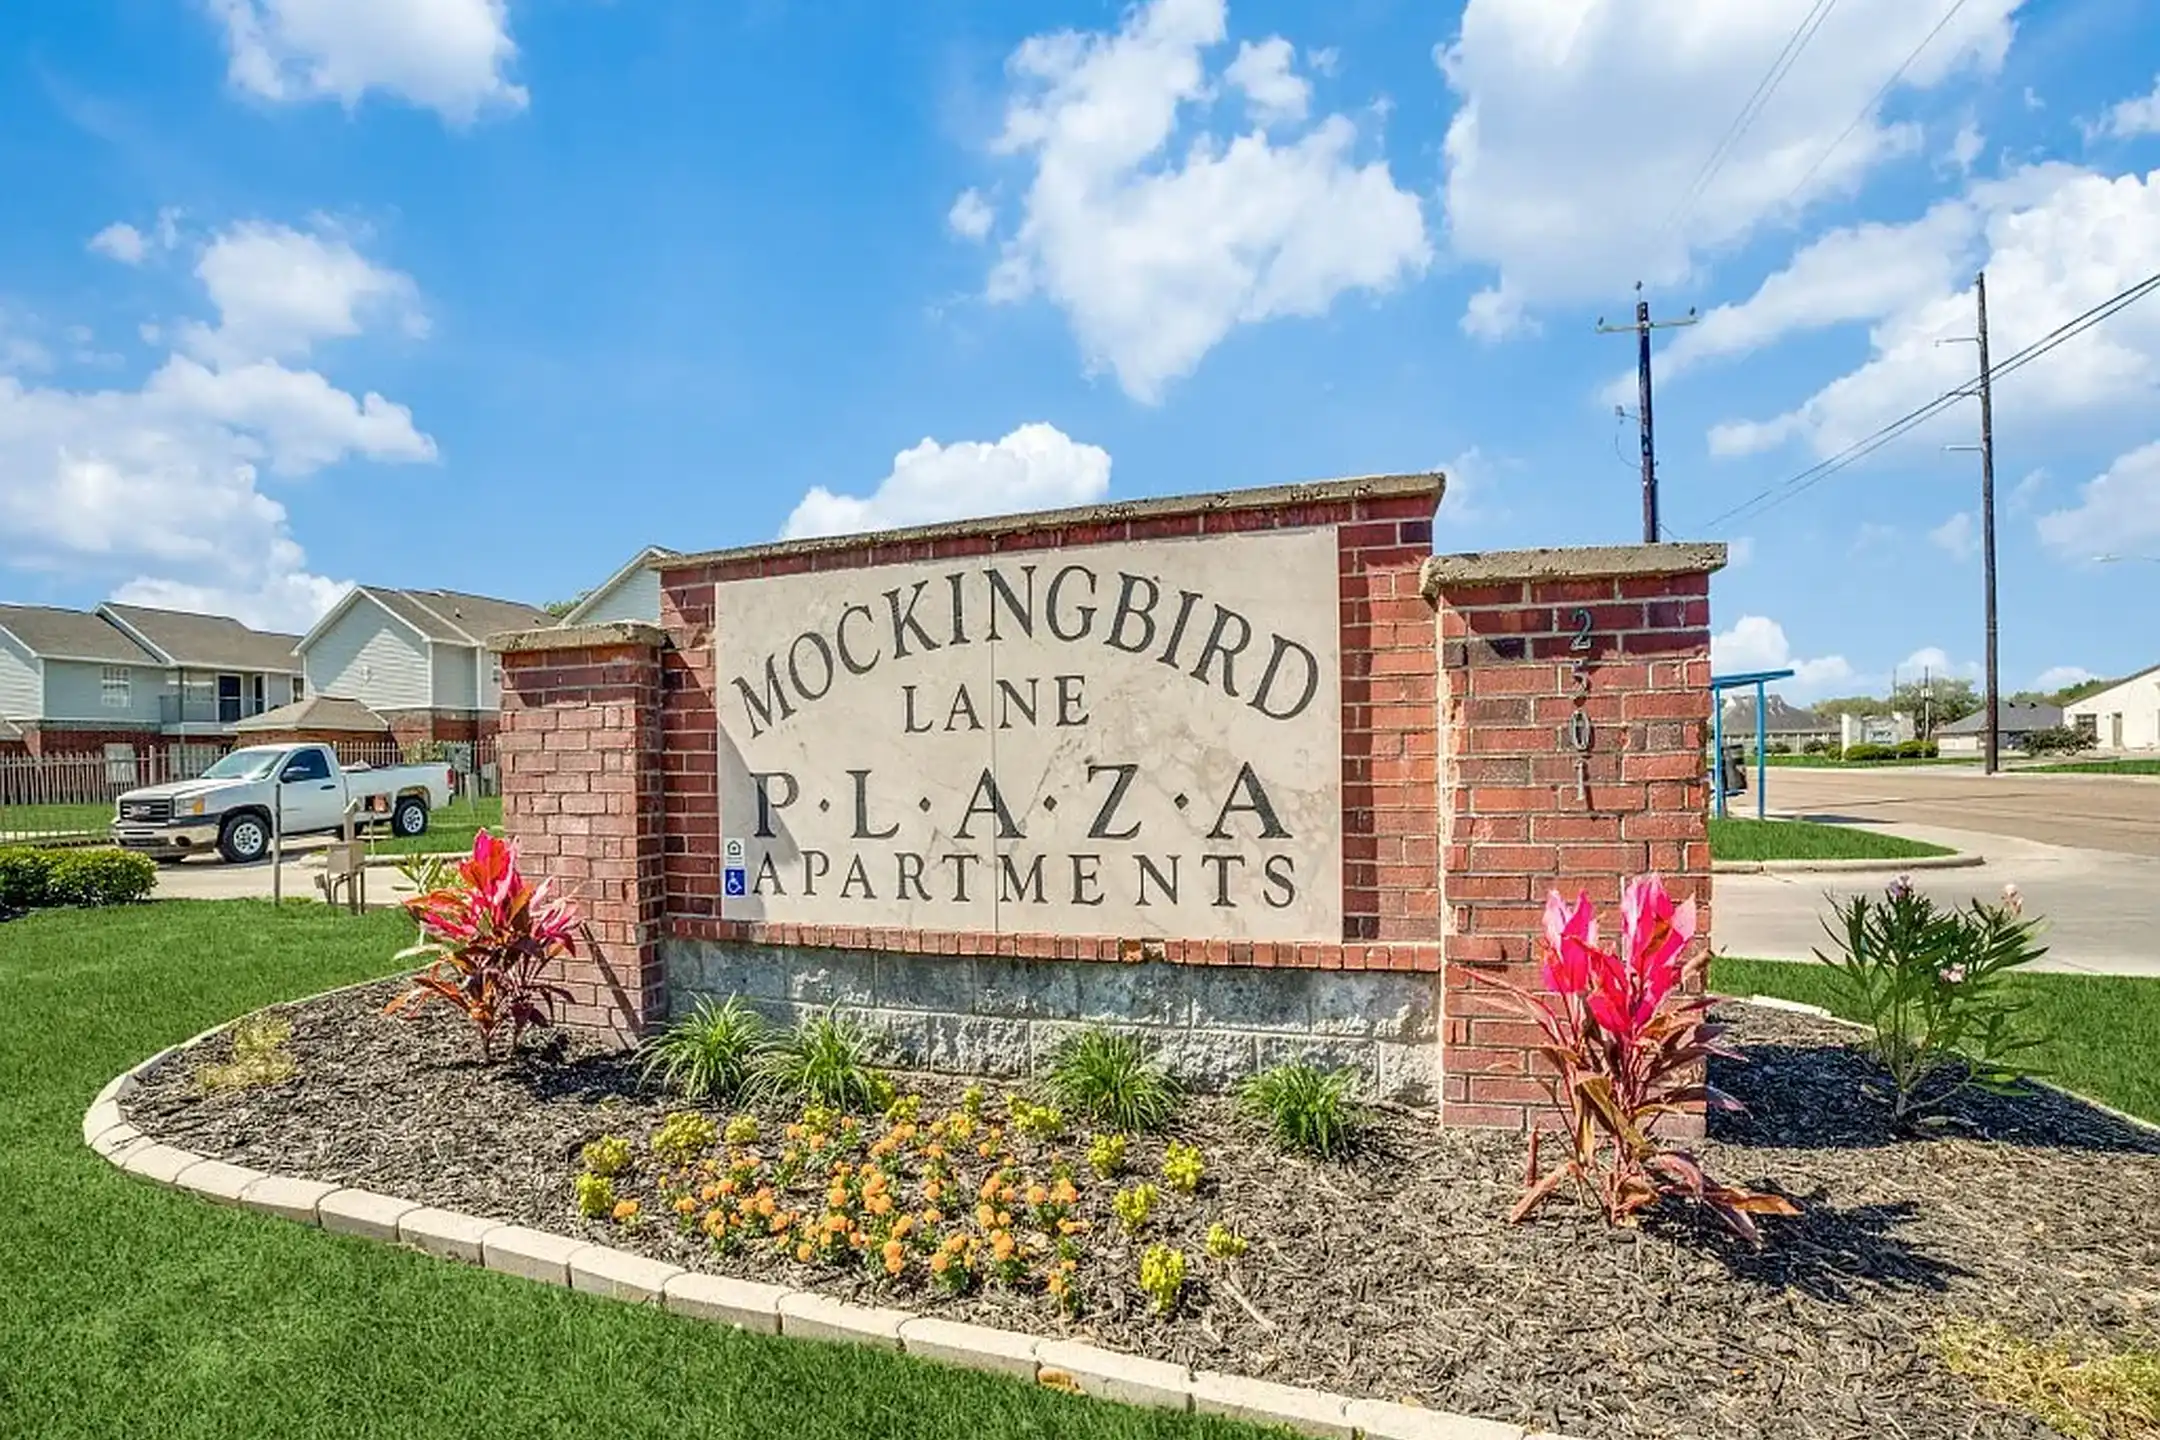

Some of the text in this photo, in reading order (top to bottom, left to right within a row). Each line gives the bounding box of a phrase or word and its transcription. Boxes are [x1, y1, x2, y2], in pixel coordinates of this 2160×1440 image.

[731, 564, 1319, 739] MOCKINGBIRD
[902, 674, 1091, 734] LANE
[752, 850, 1297, 909] APARTMENTS
